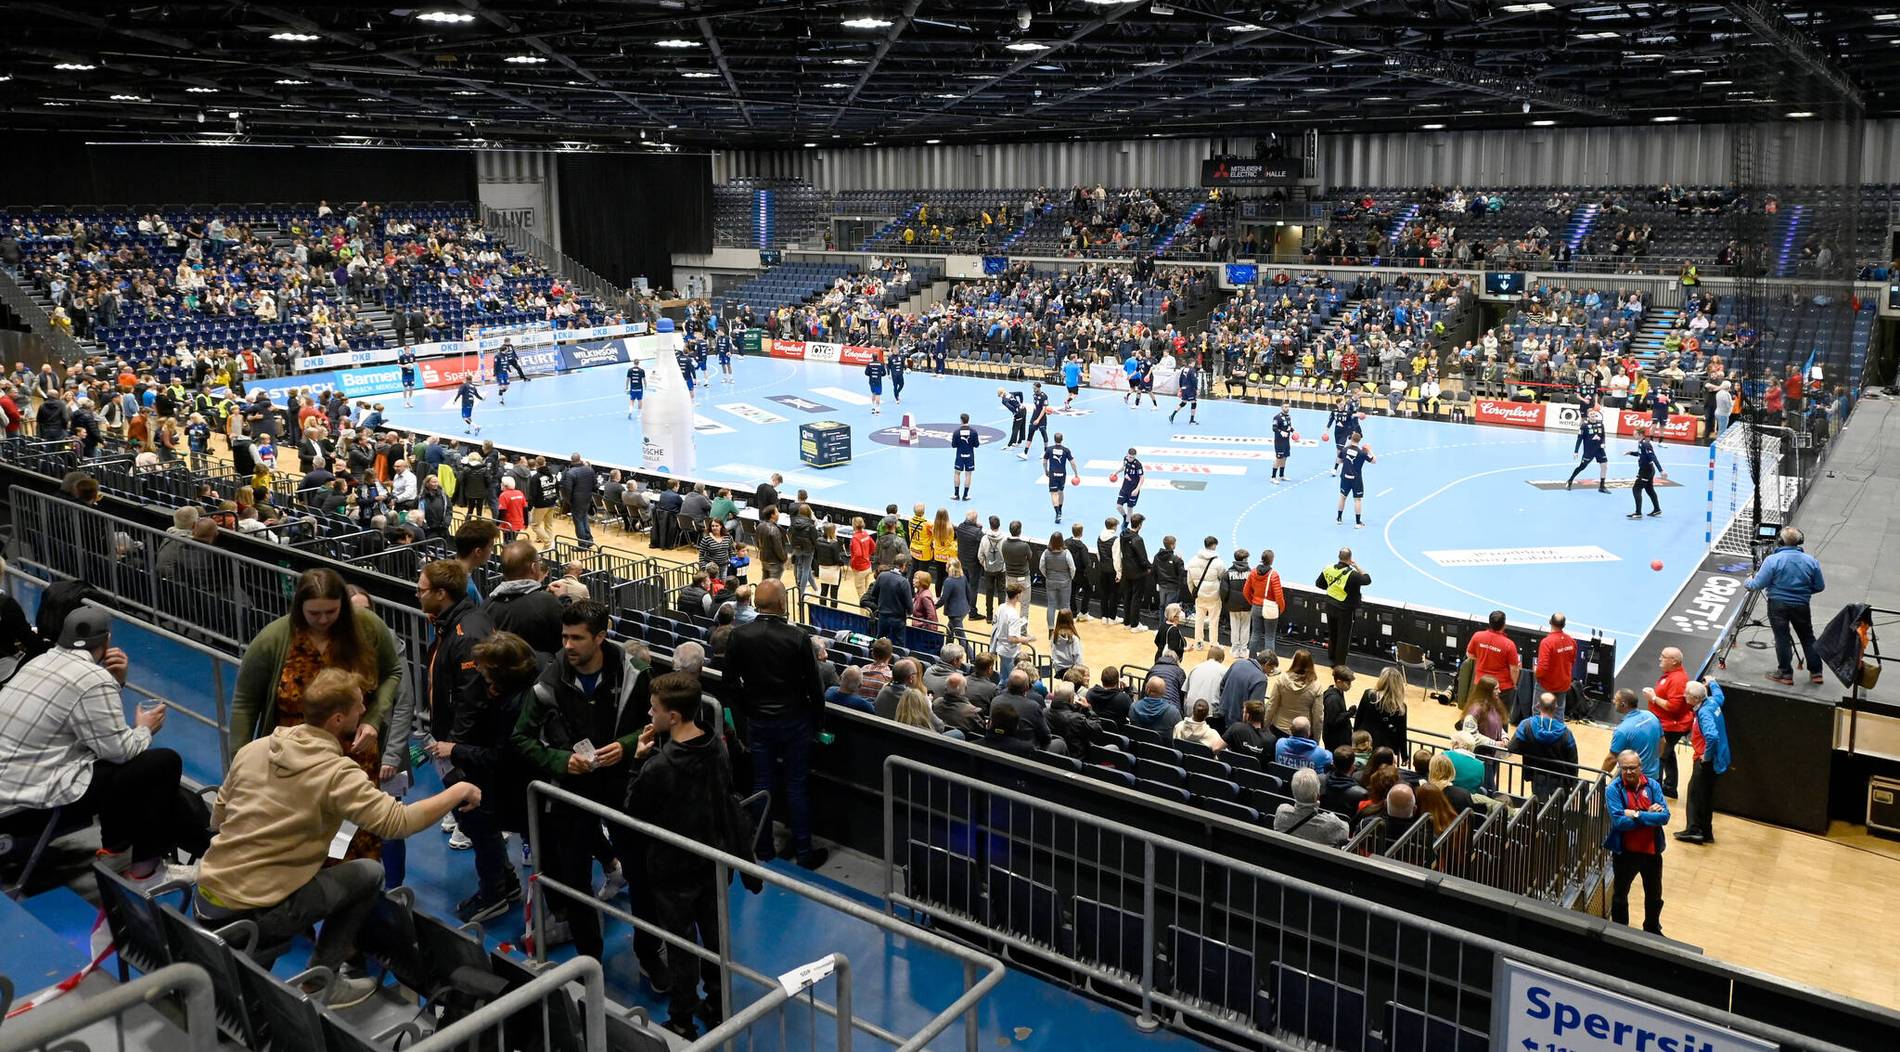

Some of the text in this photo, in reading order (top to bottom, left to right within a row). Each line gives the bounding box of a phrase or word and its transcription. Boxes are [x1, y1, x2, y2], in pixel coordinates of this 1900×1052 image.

[1265, 170, 1287, 178] HALLE
[304, 357, 324, 368] DKB
[352, 352, 371, 362] DKB
[441, 343, 458, 352] DKB
[592, 327, 608, 336] DKB
[625, 324, 640, 333] DKB
[572, 347, 618, 360] WILKINSON
[843, 347, 873, 359] Coroplas
[342, 371, 402, 387] Barmen
[269, 383, 333, 399] STCH
[1480, 401, 1541, 418] Coroplast
[1685, 576, 1741, 622] CRAFT
